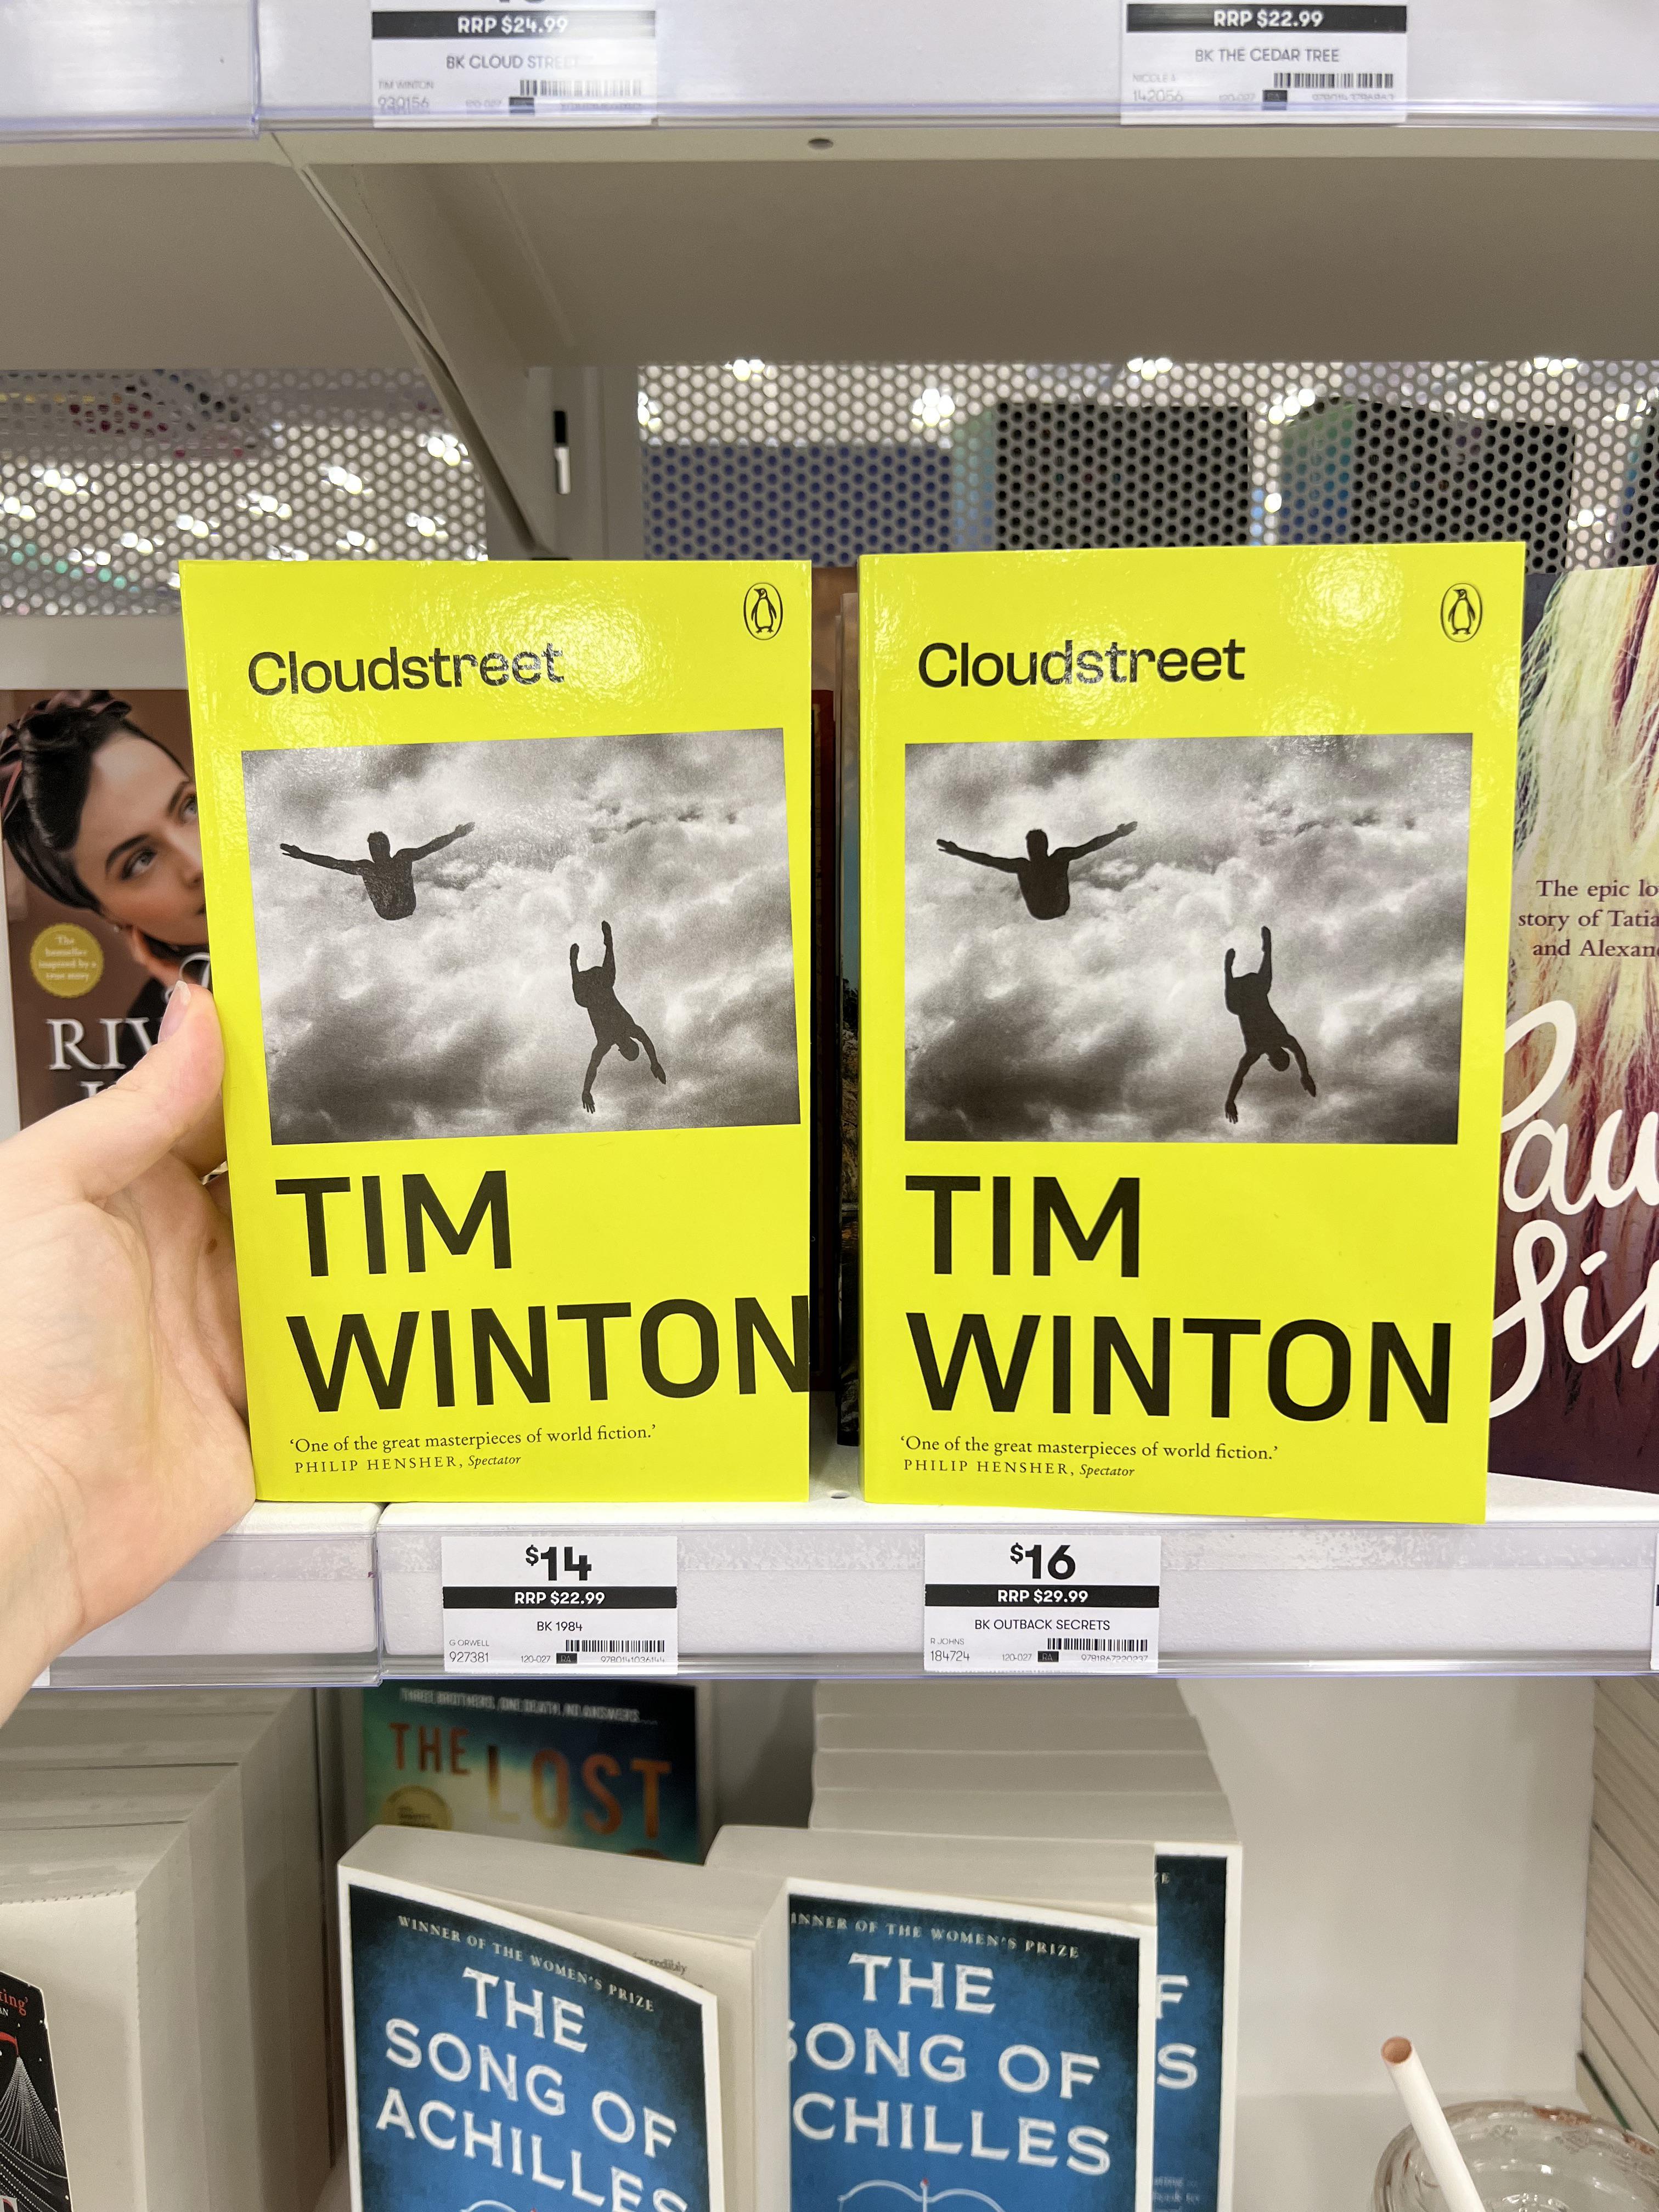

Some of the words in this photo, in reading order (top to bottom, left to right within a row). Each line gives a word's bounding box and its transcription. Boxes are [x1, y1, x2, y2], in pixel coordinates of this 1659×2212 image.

[458, 16, 496, 33] RRP
[501, 15, 568, 35] $24.99
[1213, 10, 1252, 27] RRP
[1256, 10, 1324, 29] $22.99
[446, 55, 465, 70] BK
[469, 54, 523, 70] CLOUD
[1195, 49, 1213, 63] BK
[1219, 49, 1245, 63] THE
[1249, 48, 1301, 63] CEDAR
[1305, 49, 1340, 63] TREE
[1133, 89, 1183, 102] 142056
[248, 642, 565, 696] Cloudstreet
[918, 638, 1245, 688] Cloudstreet
[1536, 879, 1578, 897] The
[1587, 880, 1630, 902] epic
[1638, 879, 1659, 897] lo
[1518, 912, 1569, 932] story
[1578, 910, 1603, 927] of
[1532, 939, 1571, 956] and
[1578, 939, 1659, 958] Alexan
[275, 1170, 512, 1277] TIM
[905, 1176, 1140, 1278] TIM
[286, 1295, 809, 1413] WINTON
[906, 1312, 1451, 1424] WINTON
[334, 1436, 349, 1451] of
[354, 1435, 378, 1451] the
[382, 1437, 420, 1453] great
[425, 1431, 521, 1449] masterpieces
[526, 1427, 543, 1443] of
[546, 1425, 592, 1442] world
[944, 1436, 961, 1451] of
[965, 1436, 989, 1452] the
[994, 1442, 1032, 1457] great
[1037, 1441, 1136, 1459] masterpieces
[1142, 1441, 1159, 1457] of
[1163, 1443, 1210, 1458] world
[295, 1459, 358, 1474] PHILIP
[367, 1455, 463, 1471] HENSHER,
[467, 1455, 522, 1470] Spectator
[904, 1459, 968, 1472] PHILIP
[977, 1461, 1074, 1477] HENSHER,
[1079, 1464, 1135, 1479] Spectator
[525, 1544, 592, 1582] $14
[1009, 1542, 1076, 1581] $16
[514, 1591, 546, 1605] RRP
[550, 1590, 605, 1606] $22.99
[997, 1589, 1030, 1603] RRP
[1033, 1588, 1089, 1604] $29.99
[537, 1621, 552, 1632] BK
[555, 1621, 583, 1632] 1984
[974, 1619, 990, 1630] BK
[994, 1618, 1053, 1630] OUTBACK
[1056, 1619, 1111, 1631] SECRETS
[449, 1652, 489, 1663] 927381
[521, 1655, 551, 1663] 120-027
[930, 1650, 970, 1662] 184724
[1002, 1654, 1032, 1662] 120-027
[389, 1723, 471, 1775] THE
[487, 1745, 672, 1839] LOST
[790, 1911, 847, 1930] INNER
[855, 1920, 878, 1934] OF
[885, 1922, 922, 1938] THE
[1025, 1939, 1080, 1959] PRIZE
[398, 1915, 461, 1943] WINNER
[466, 1934, 487, 1949] OF
[492, 1942, 524, 1962] THE
[608, 1983, 654, 2012] PRIZE
[848, 1952, 996, 2015] THE
[462, 1966, 588, 2053] THE
[998, 2044, 1100, 2100] OF
[385, 2018, 567, 2116] SONG
[592, 2090, 678, 2158] OF
[792, 2091, 1111, 2176] CHILLES
